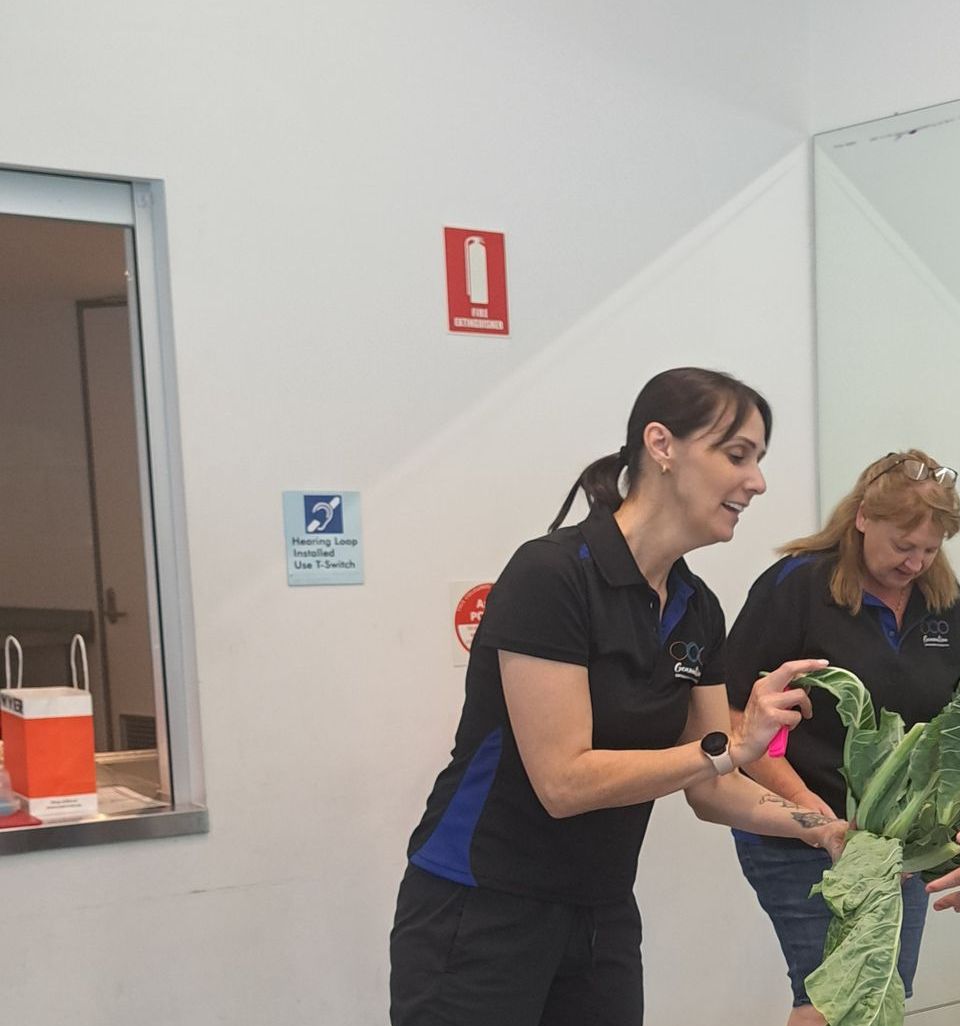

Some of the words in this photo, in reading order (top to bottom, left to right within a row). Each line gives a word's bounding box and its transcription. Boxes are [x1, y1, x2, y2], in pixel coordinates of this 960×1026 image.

[291, 537, 331, 547] Hearing
[334, 536, 358, 547] Loop
[293, 548, 335, 558] Installed
[294, 560, 312, 570] Use
[316, 559, 356, 569] T-Switch
